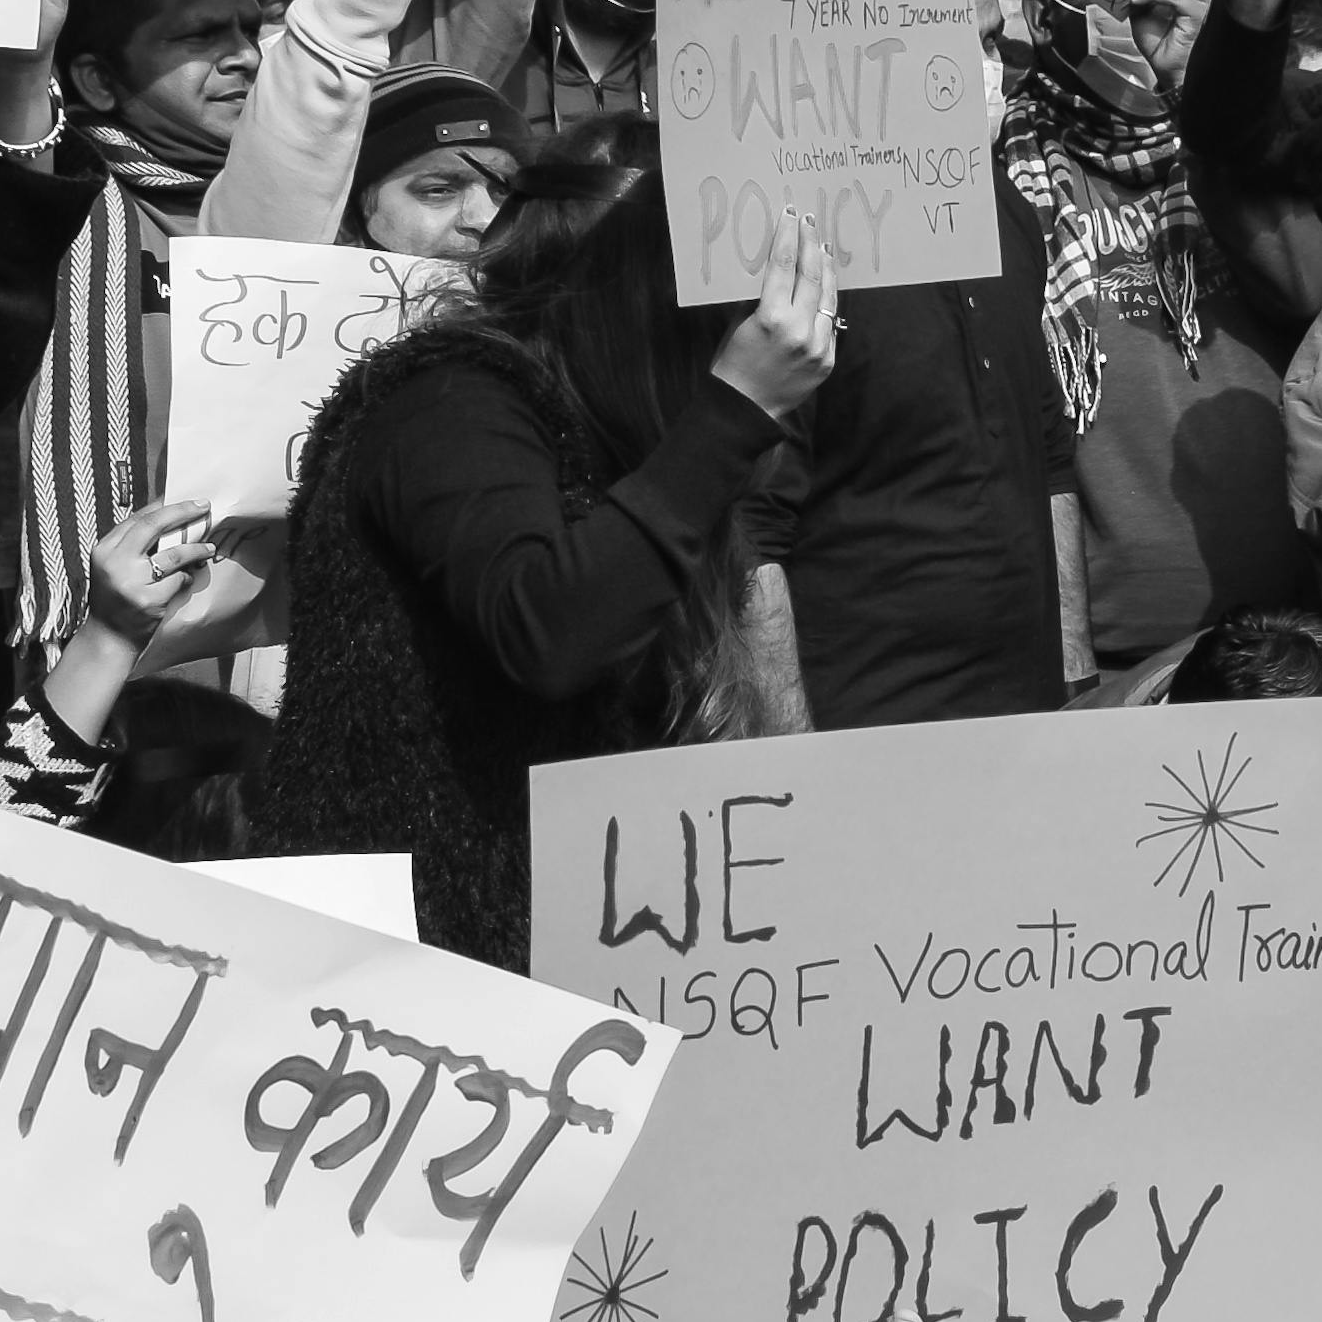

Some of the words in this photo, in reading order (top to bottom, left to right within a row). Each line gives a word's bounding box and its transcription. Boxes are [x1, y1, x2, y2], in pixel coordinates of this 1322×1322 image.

[862, 0, 890, 30] NO
[728, 31, 908, 144] WANT
[901, 144, 982, 189] NSQF
[922, 200, 962, 235] VT
[697, 174, 894, 287] POICY
[195, 267, 321, 368] हक
[1097, 289, 1159, 307] INTAG
[598, 790, 796, 956] WE
[613, 957, 840, 1051] NSQF
[873, 889, 1218, 1006] Vocational
[855, 1004, 1173, 1151] WANT
[242, 1005, 649, 1283] कार्य
